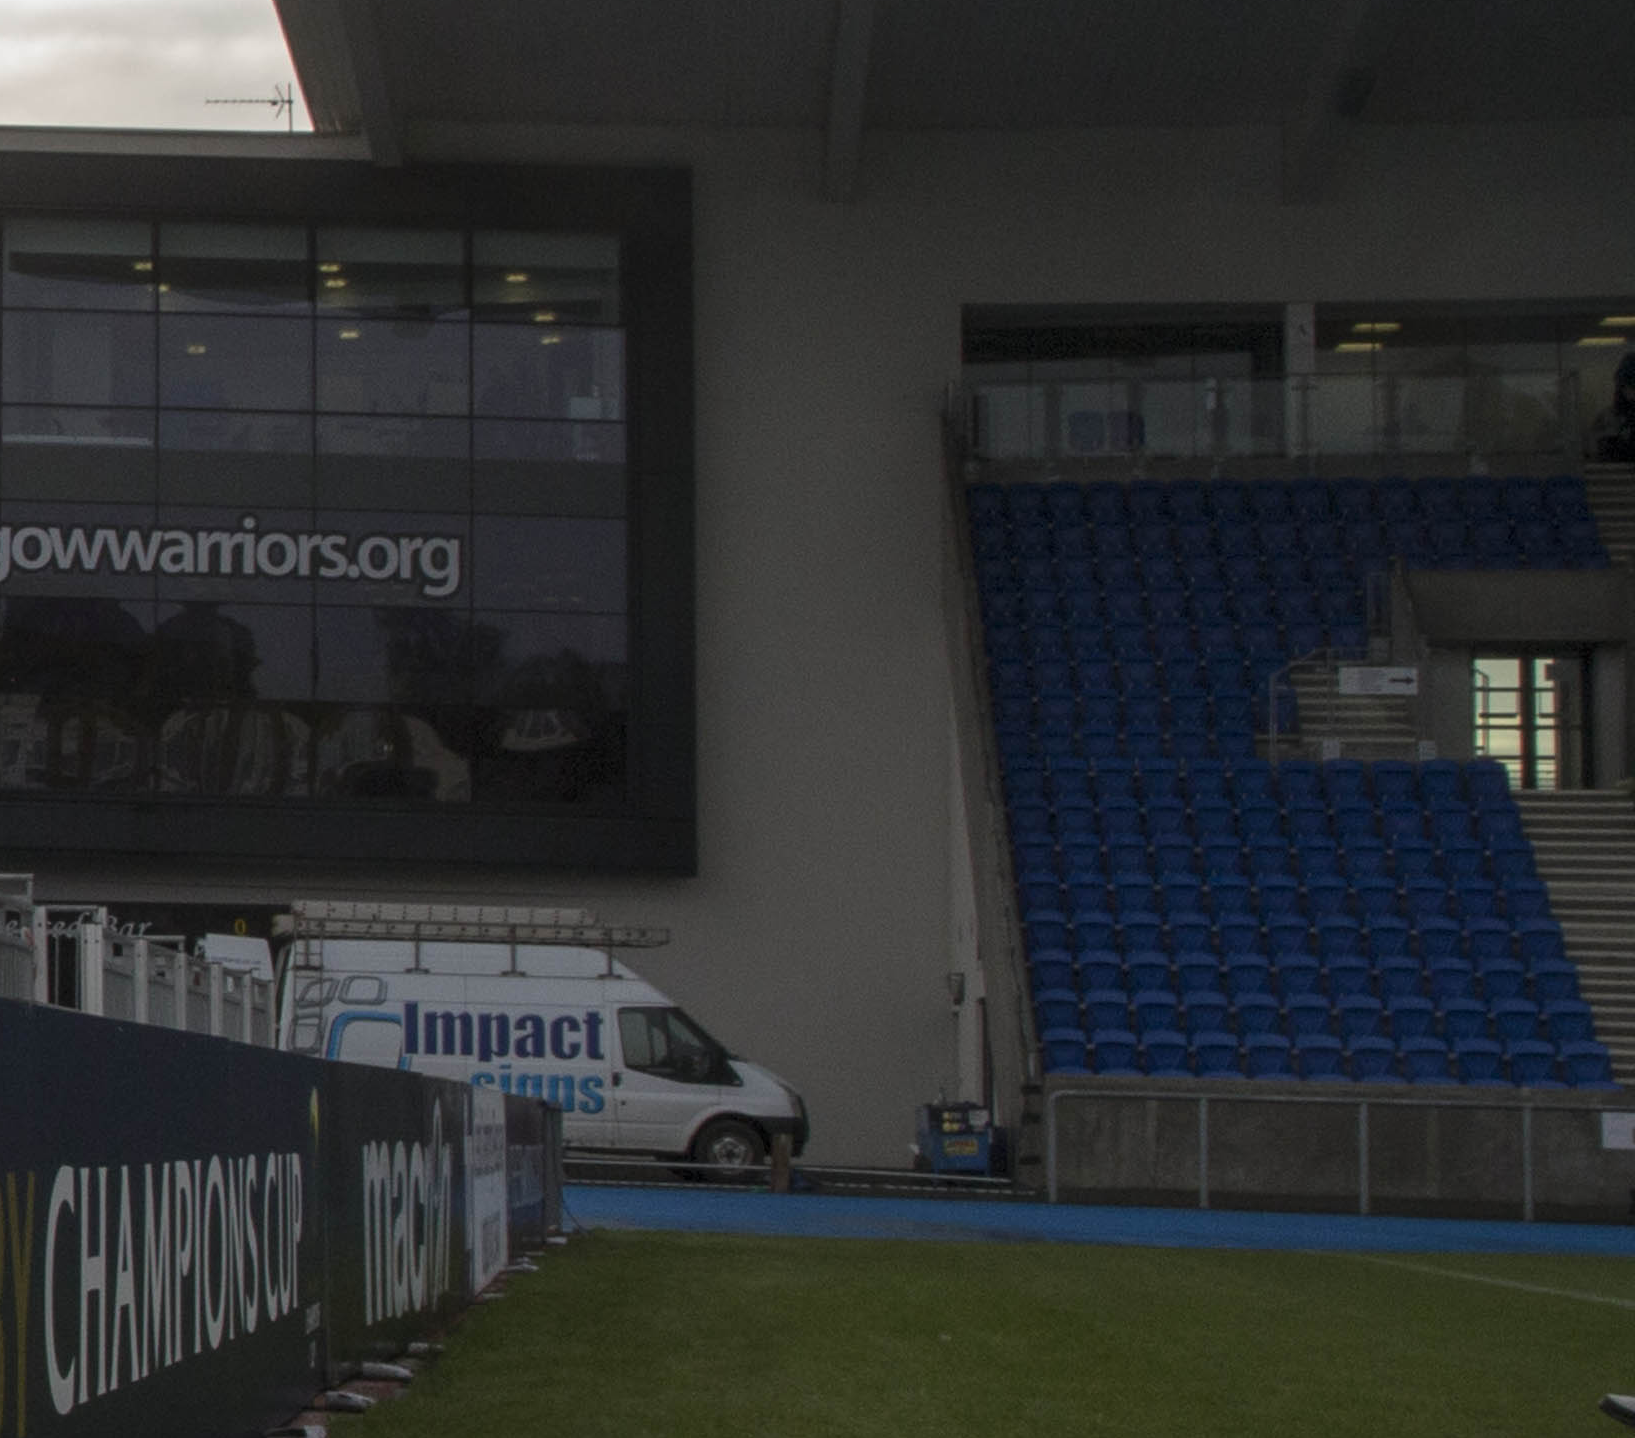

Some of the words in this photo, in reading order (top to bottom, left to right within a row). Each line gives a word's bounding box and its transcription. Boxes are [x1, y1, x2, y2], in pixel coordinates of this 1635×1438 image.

[404, 1002, 604, 1061] Impact
[44, 1153, 260, 1415] CHAMPIONS
[264, 1152, 302, 1321] CUP
